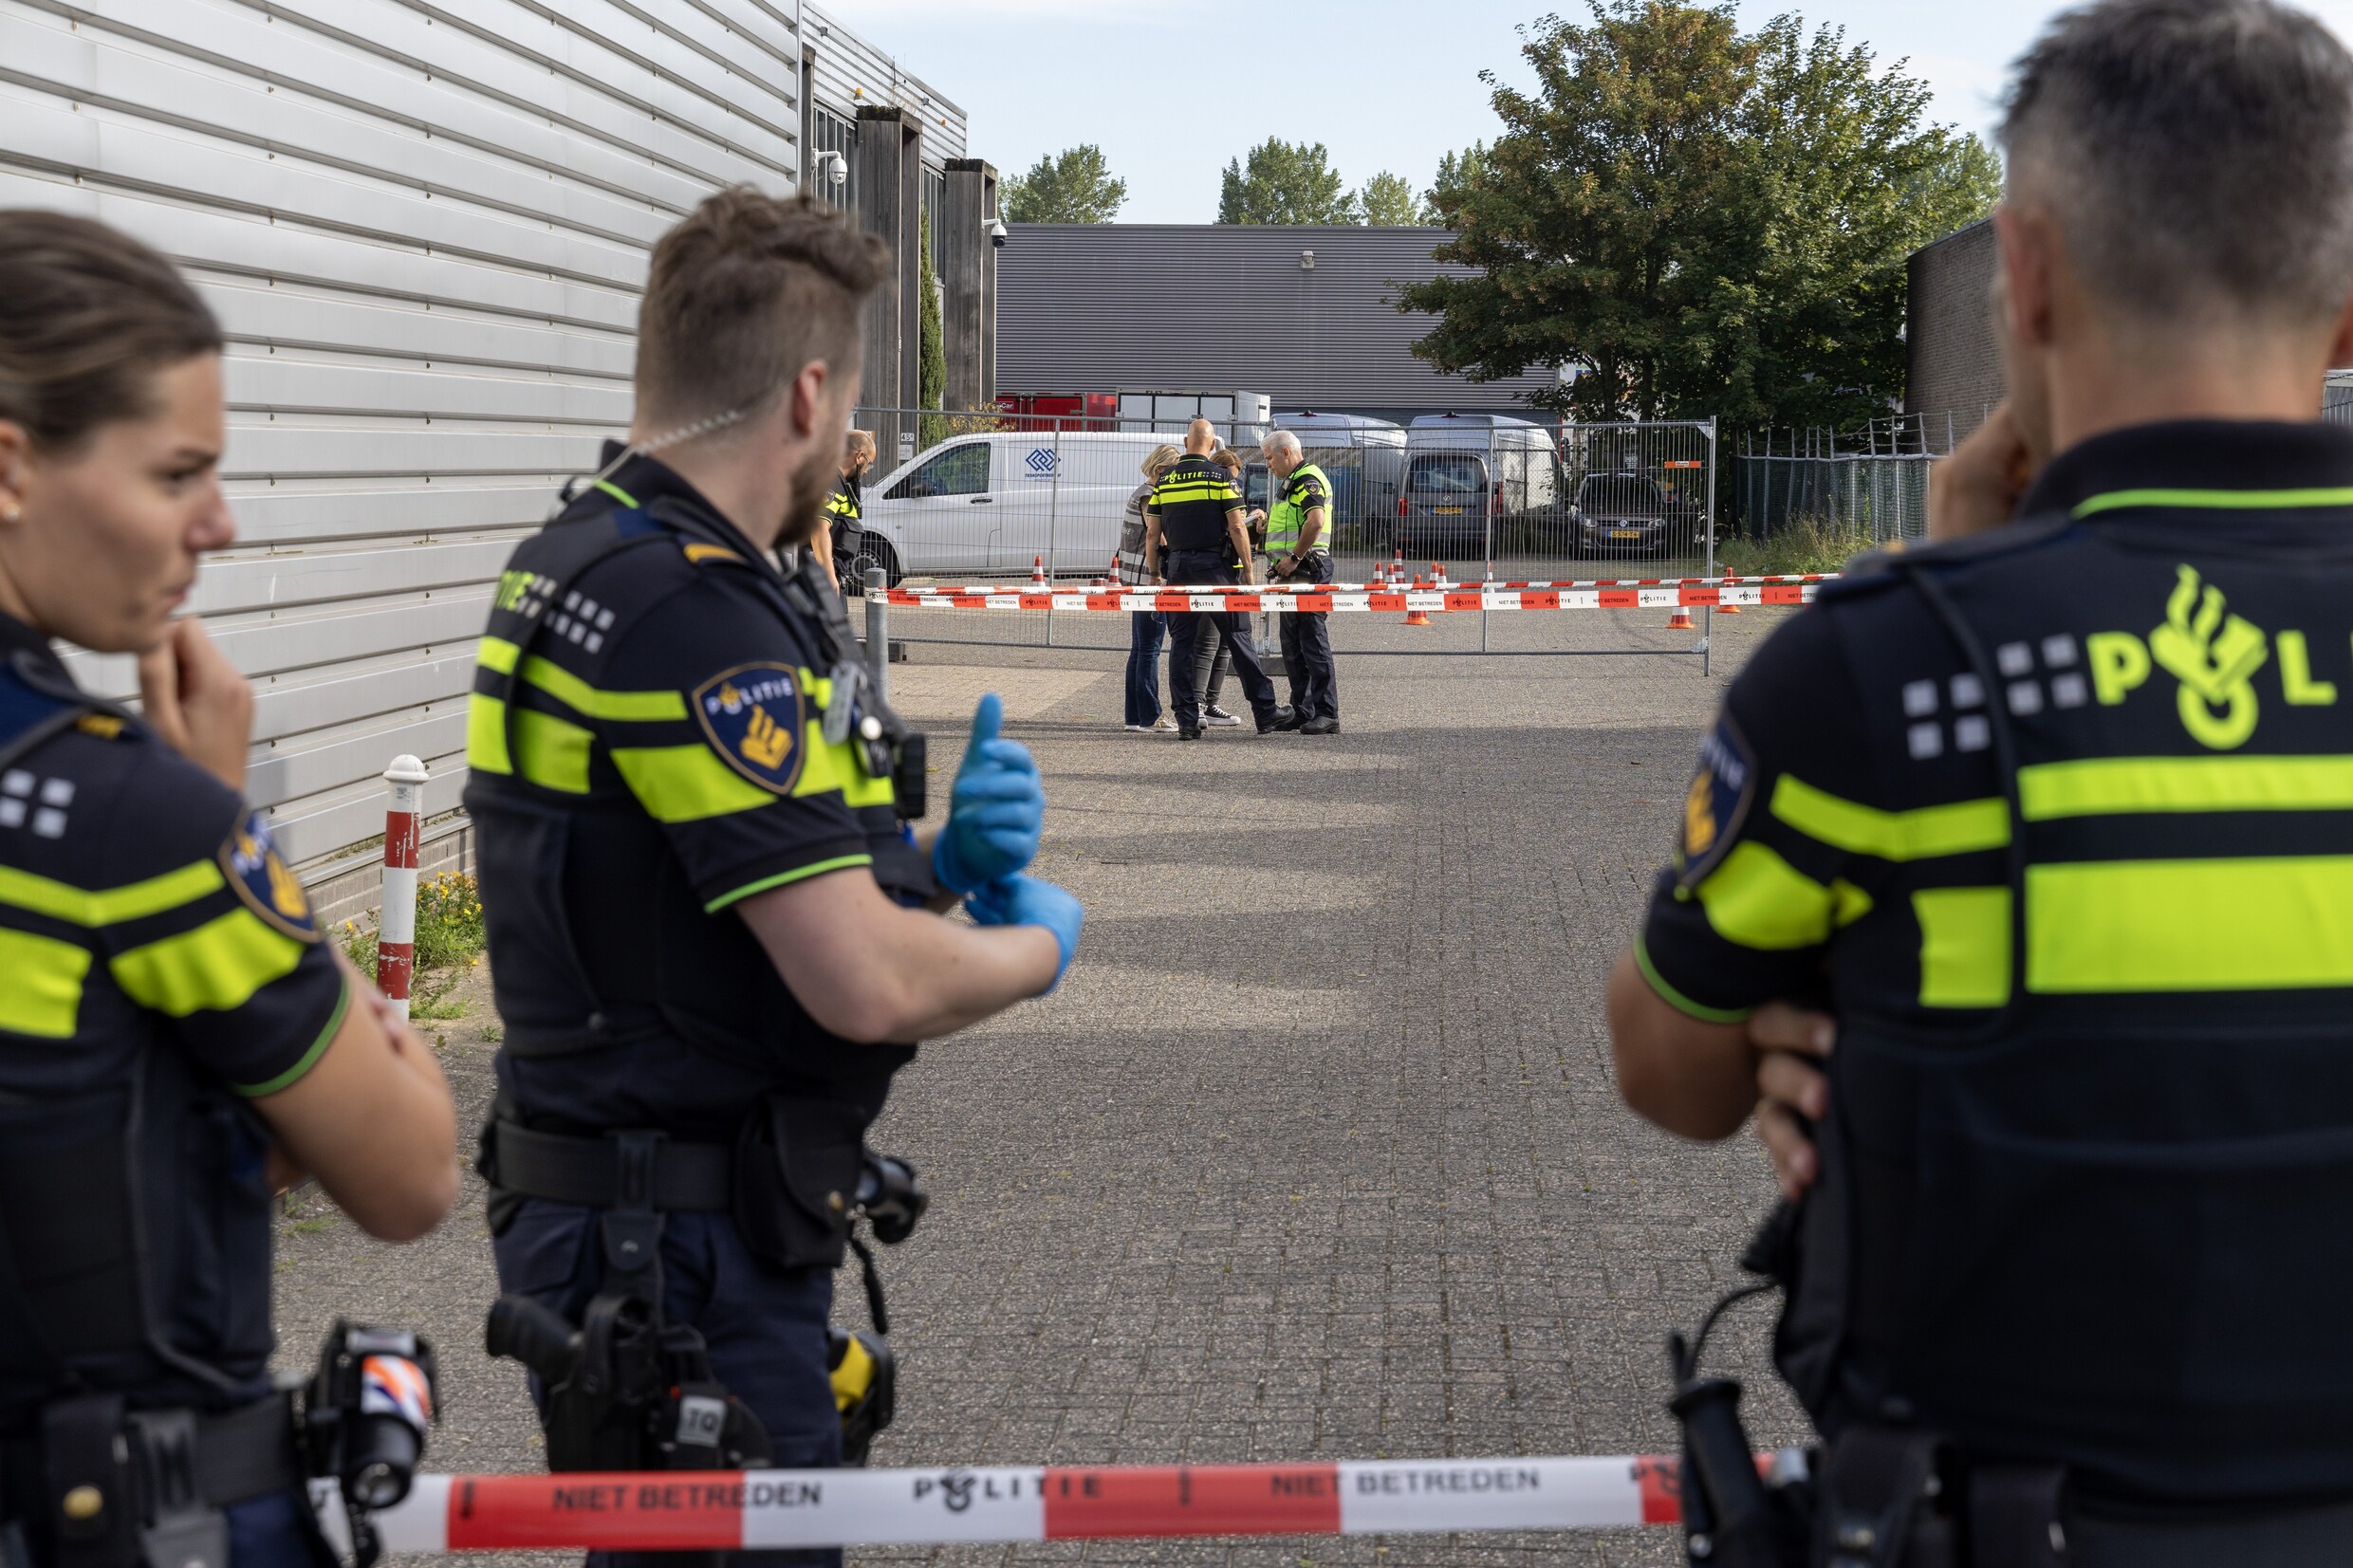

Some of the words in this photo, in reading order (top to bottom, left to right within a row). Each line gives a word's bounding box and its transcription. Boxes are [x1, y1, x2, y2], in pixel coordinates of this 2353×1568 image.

[1164, 470, 1203, 483] POLITIE
[1191, 600, 1214, 608] POLITIE
[1276, 600, 1299, 608] POLITIE
[1453, 598, 1477, 607] POLITIE
[1546, 596, 1571, 605] POLITIE
[1640, 594, 1666, 603] POLITIE
[1739, 591, 1765, 600] POLITIE
[2085, 563, 2353, 750] POL
[705, 677, 794, 715] POLITIE
[551, 1483, 630, 1511] NIET
[639, 1480, 824, 1511] BETREDEN
[913, 1469, 1102, 1513] POLITIE
[1270, 1473, 1343, 1496] NIET
[1356, 1467, 1541, 1496] BETREDEN
